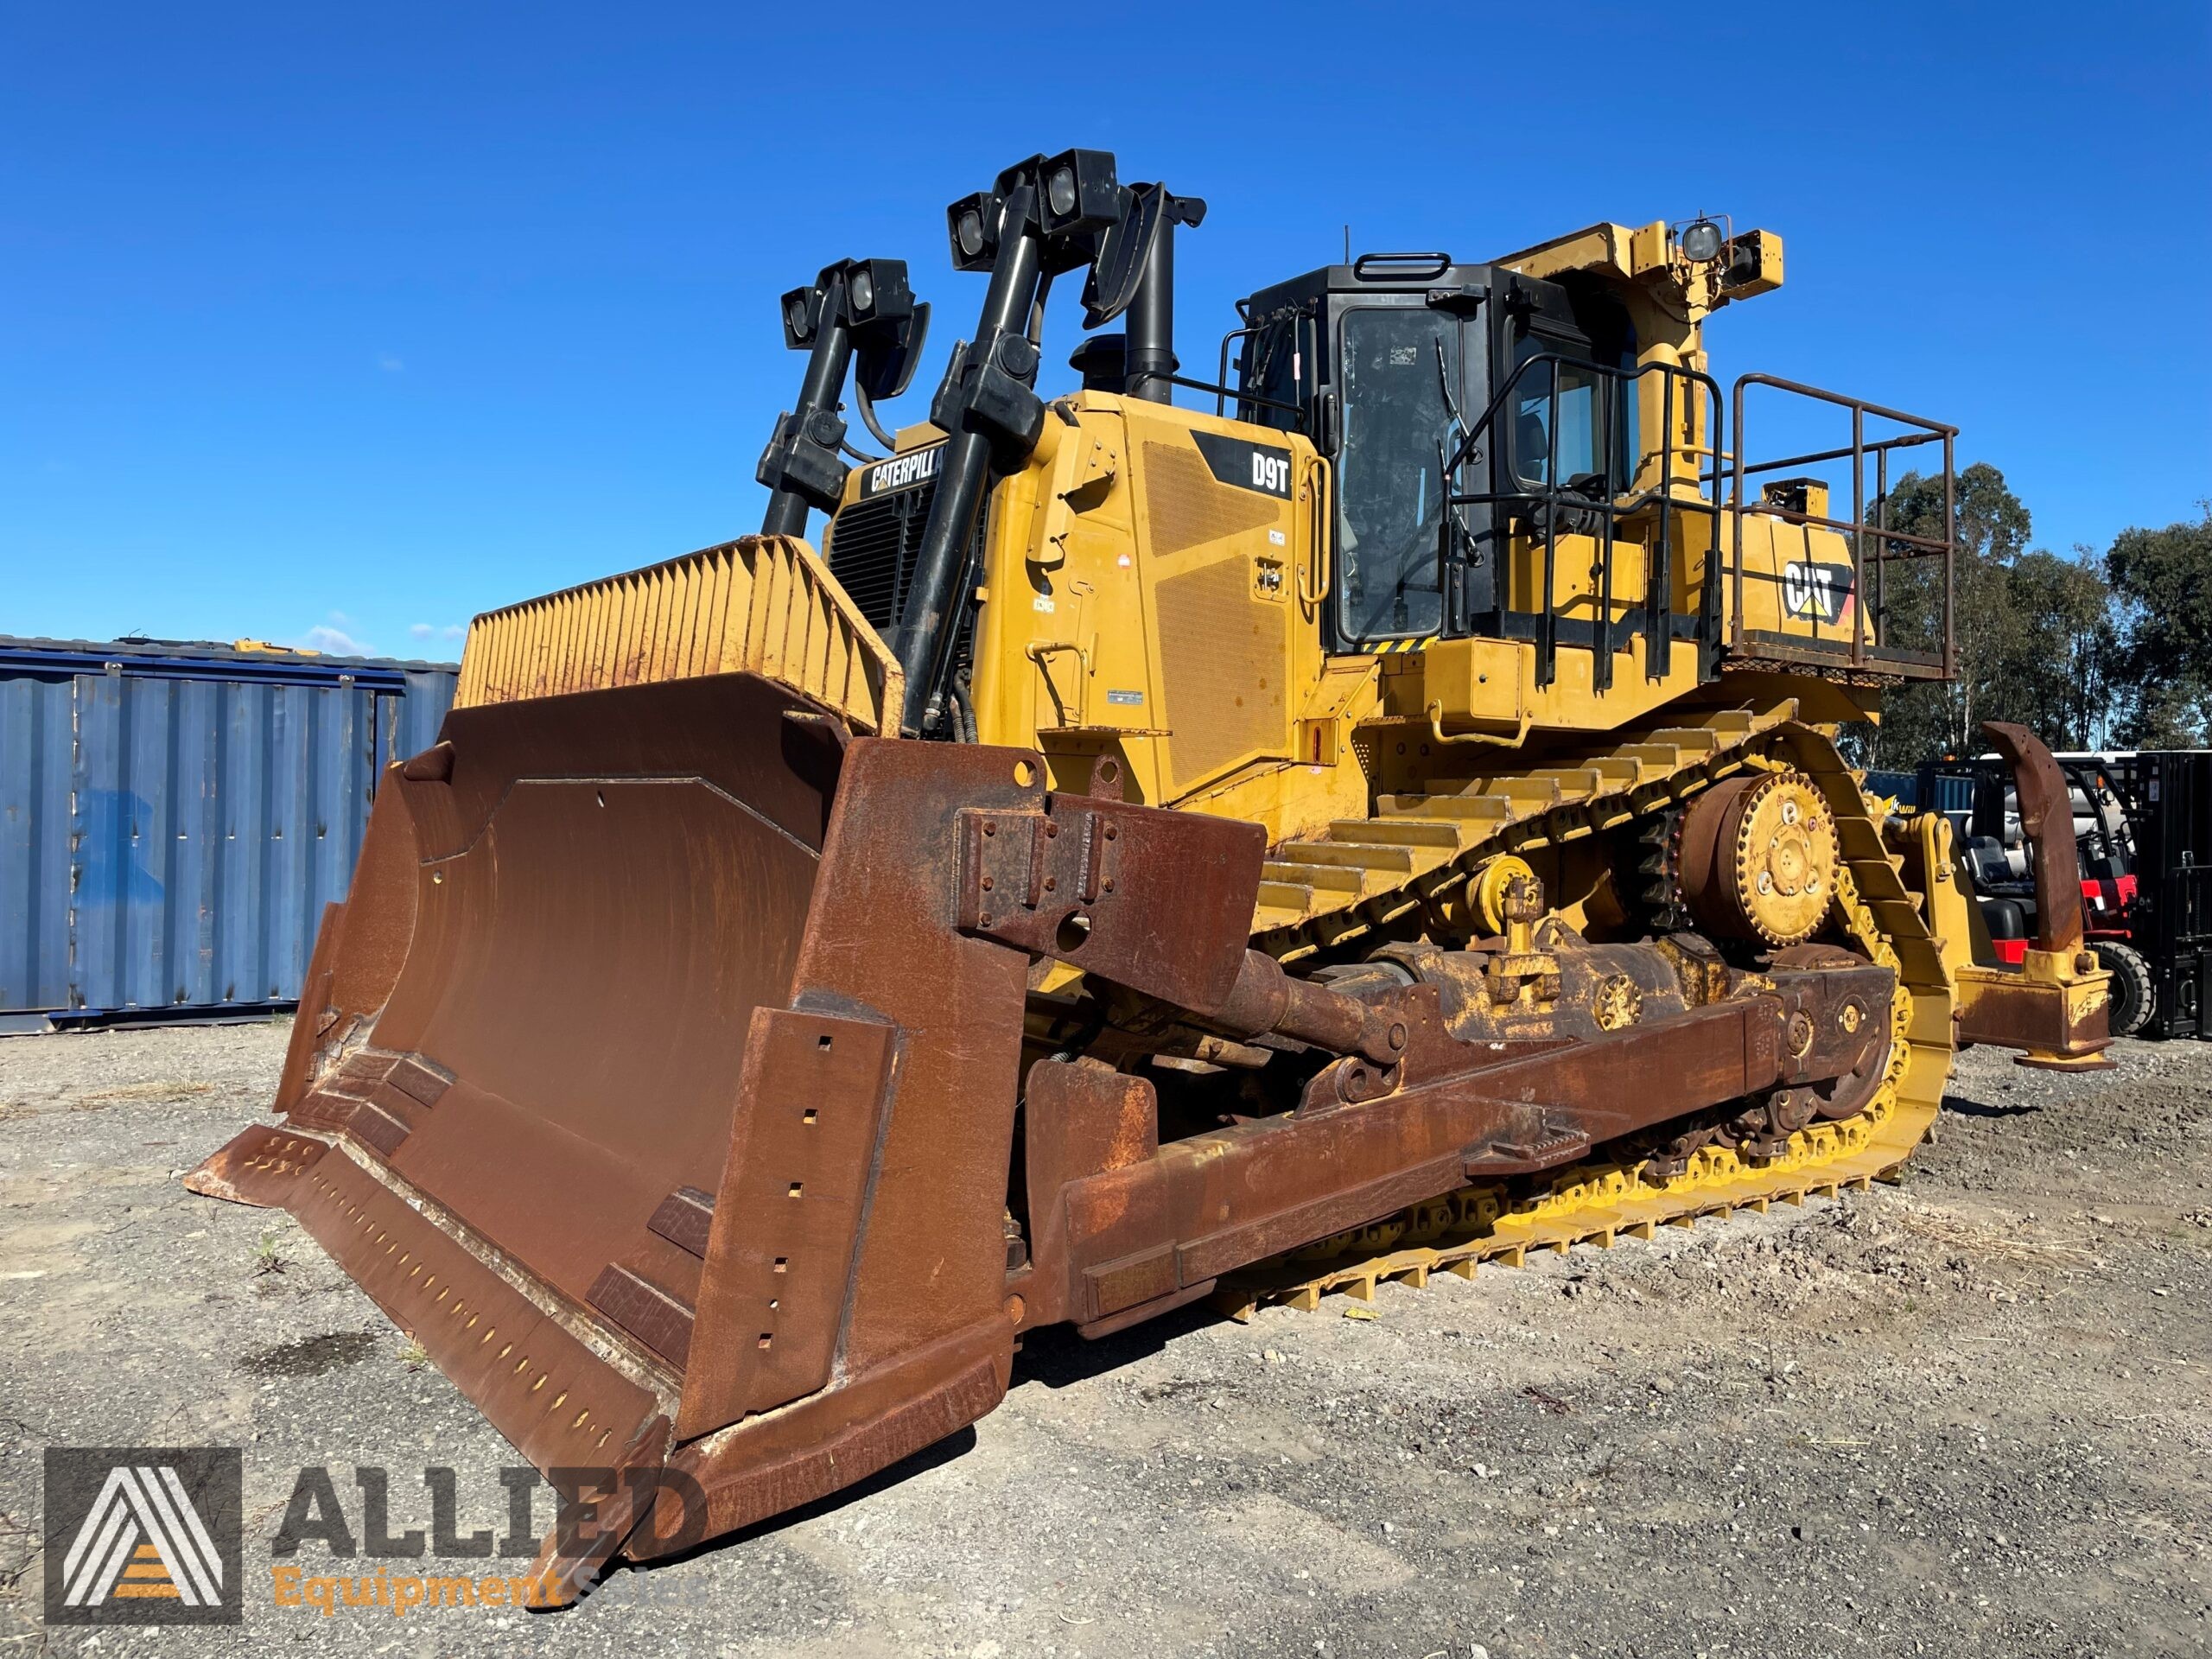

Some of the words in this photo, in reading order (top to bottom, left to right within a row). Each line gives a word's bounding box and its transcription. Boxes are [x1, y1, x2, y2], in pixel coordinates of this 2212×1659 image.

[871, 446, 944, 493] CATERPILLA
[1252, 452, 1289, 493] D9T
[1784, 563, 1833, 617] CAT
